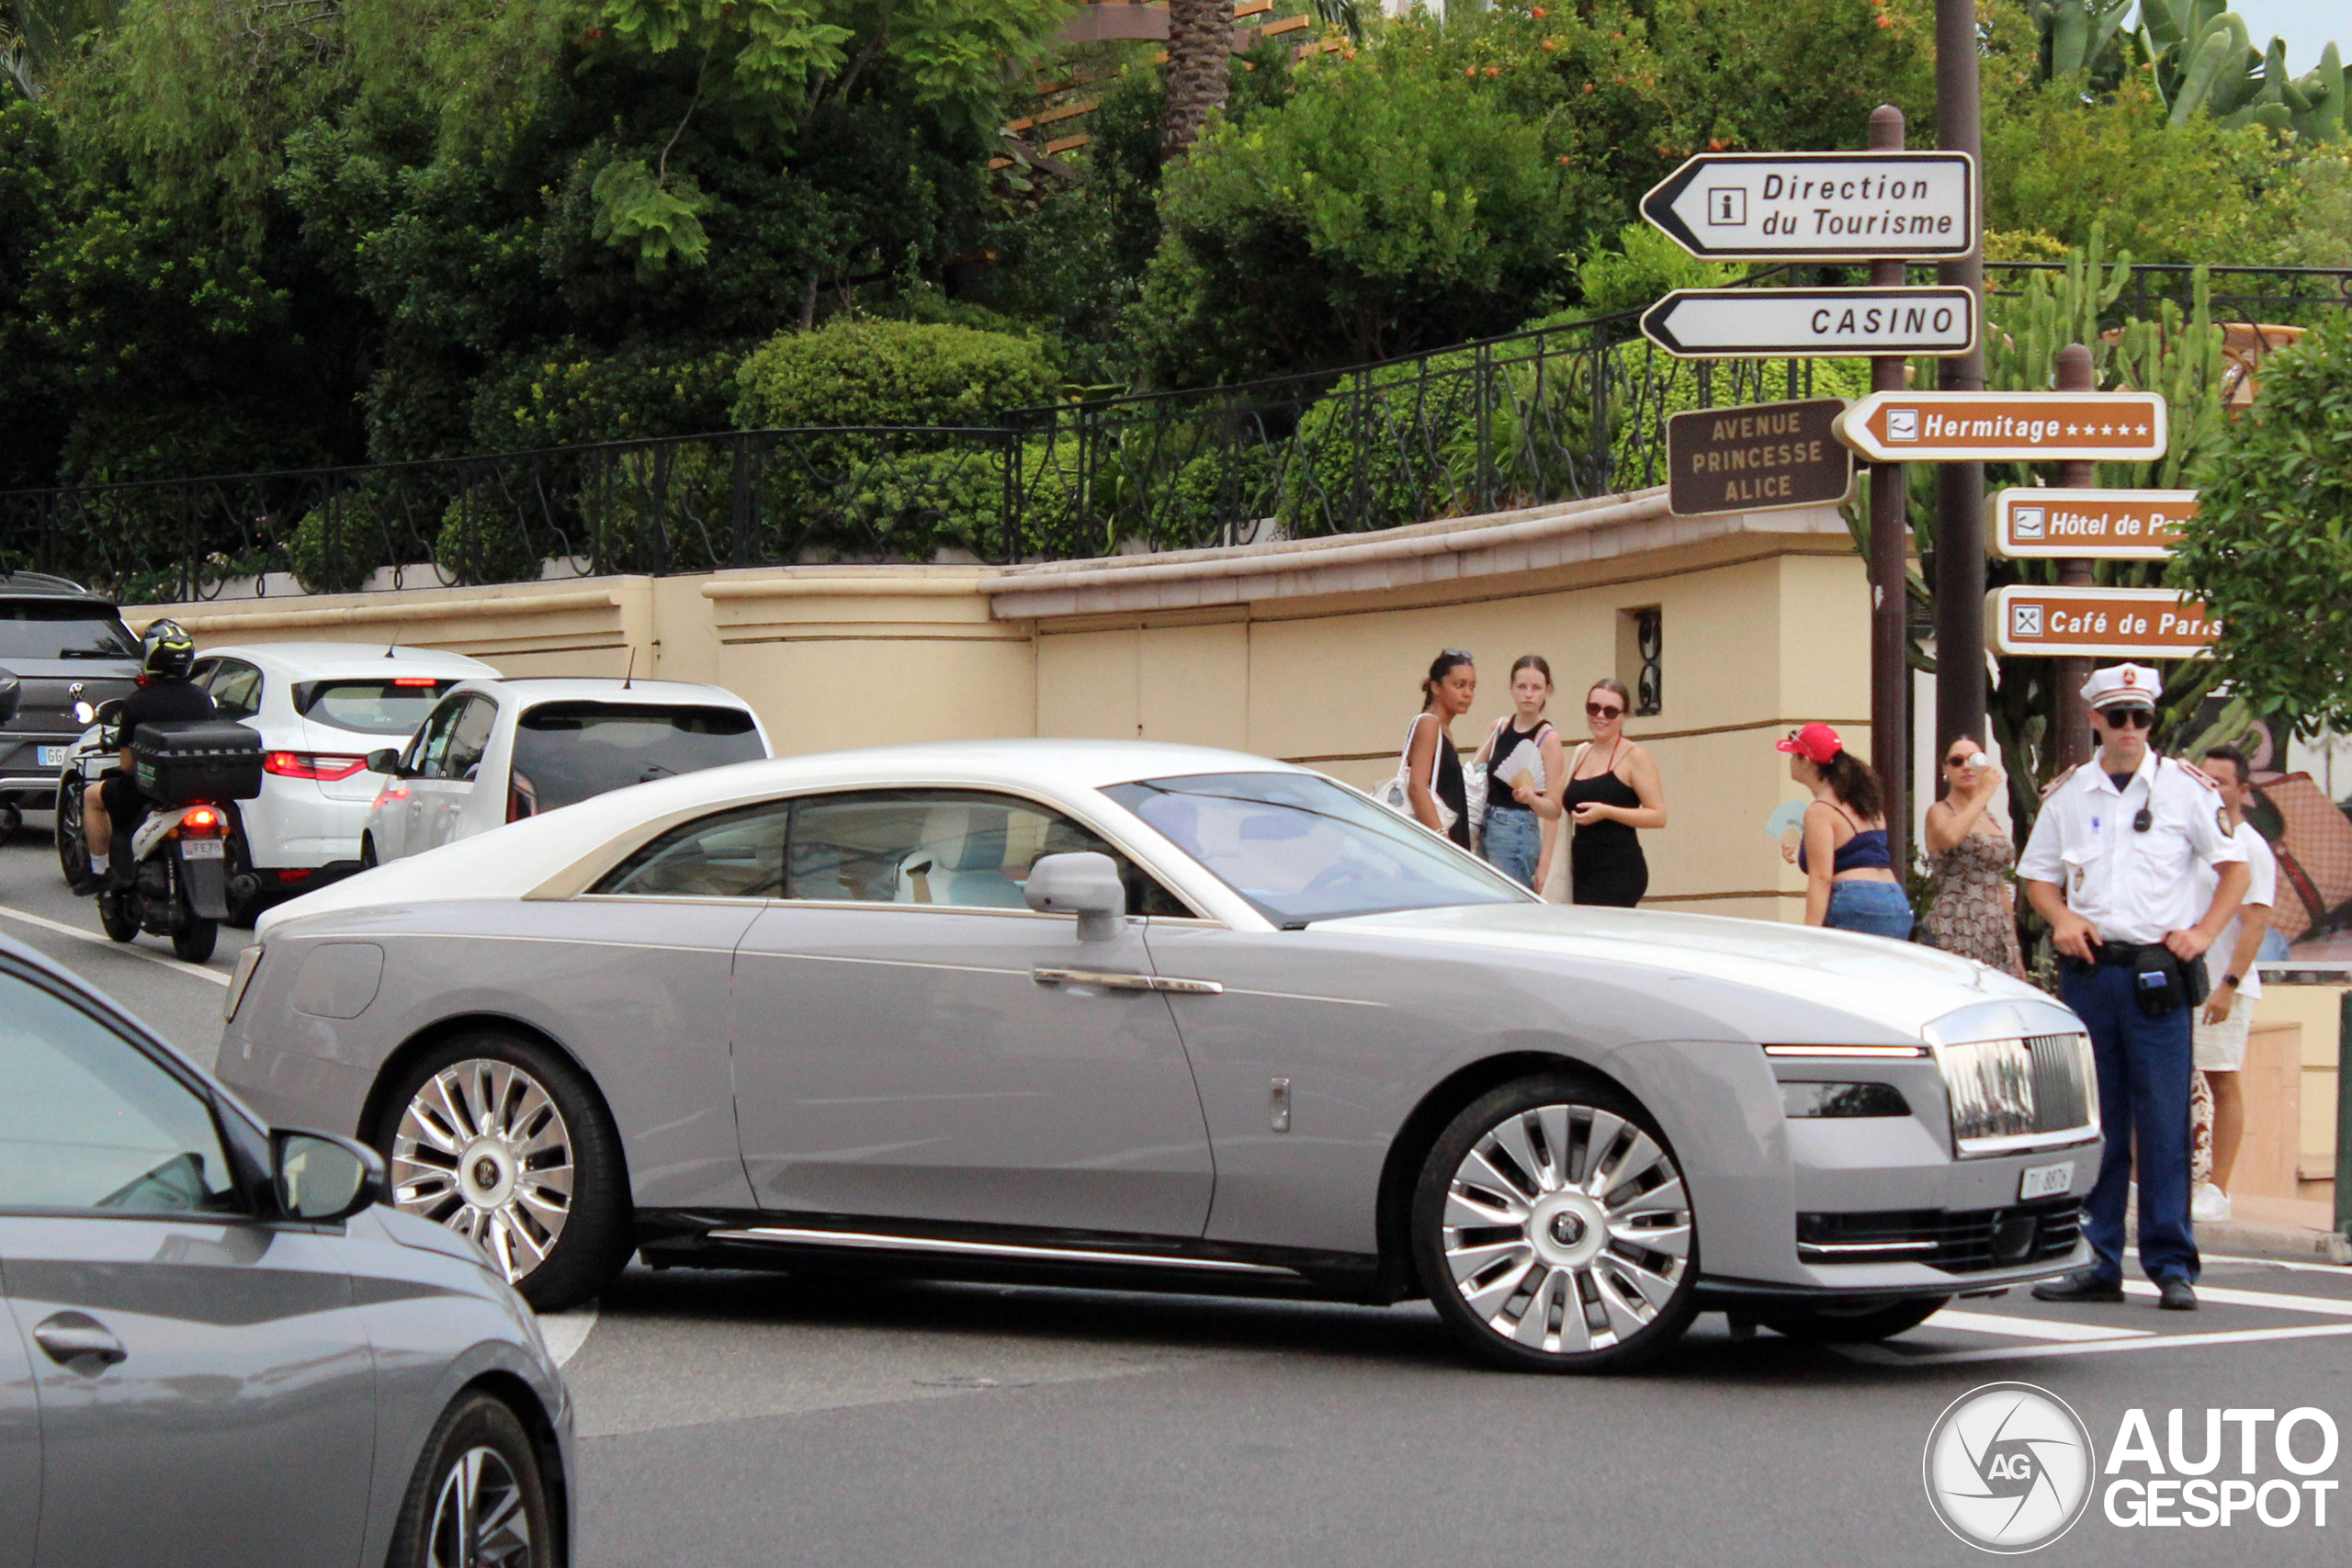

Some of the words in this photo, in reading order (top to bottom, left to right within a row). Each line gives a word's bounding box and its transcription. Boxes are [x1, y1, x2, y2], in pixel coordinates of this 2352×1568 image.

[1762, 174, 1928, 200] Direction
[1762, 210, 1798, 235] du
[1813, 209, 1952, 235] Tourisme
[1811, 307, 1953, 334] CASINO
[1712, 412, 1802, 442] AVENUE
[1924, 413, 2061, 443] Hermitage
[1692, 440, 1823, 474] PRINCESSE
[1724, 475, 1792, 502] ALICE
[2049, 512, 2109, 536] Hôtel
[2115, 513, 2142, 536] de
[2050, 610, 2108, 633] Café
[2119, 614, 2147, 635] de
